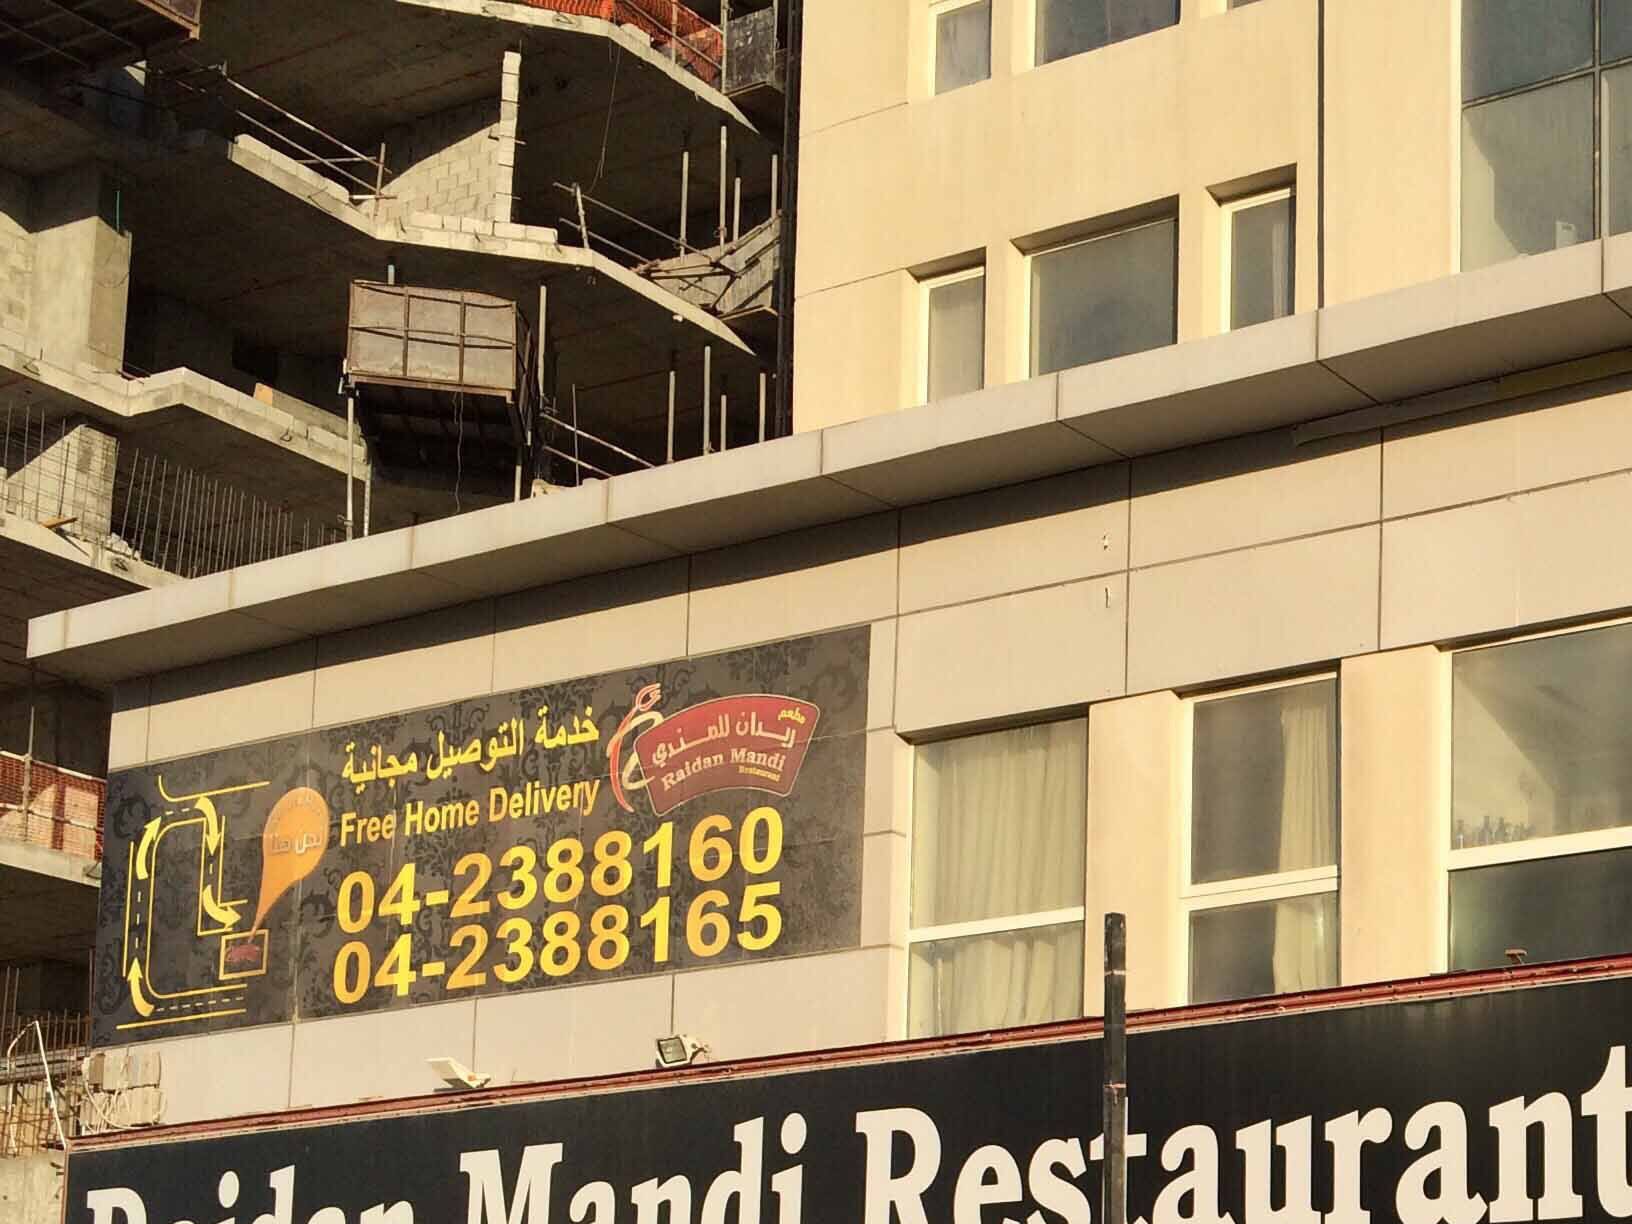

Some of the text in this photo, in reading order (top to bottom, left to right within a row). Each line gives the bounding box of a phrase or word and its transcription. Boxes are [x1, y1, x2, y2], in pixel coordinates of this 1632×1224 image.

[342, 705, 600, 794] خدمة التوصيل مجانية
[661, 748, 786, 791] Raidan Mandi
[340, 779, 600, 847] Free Home Delivery
[336, 806, 783, 933] 04-2388160
[332, 881, 782, 1004] 04-2388165
